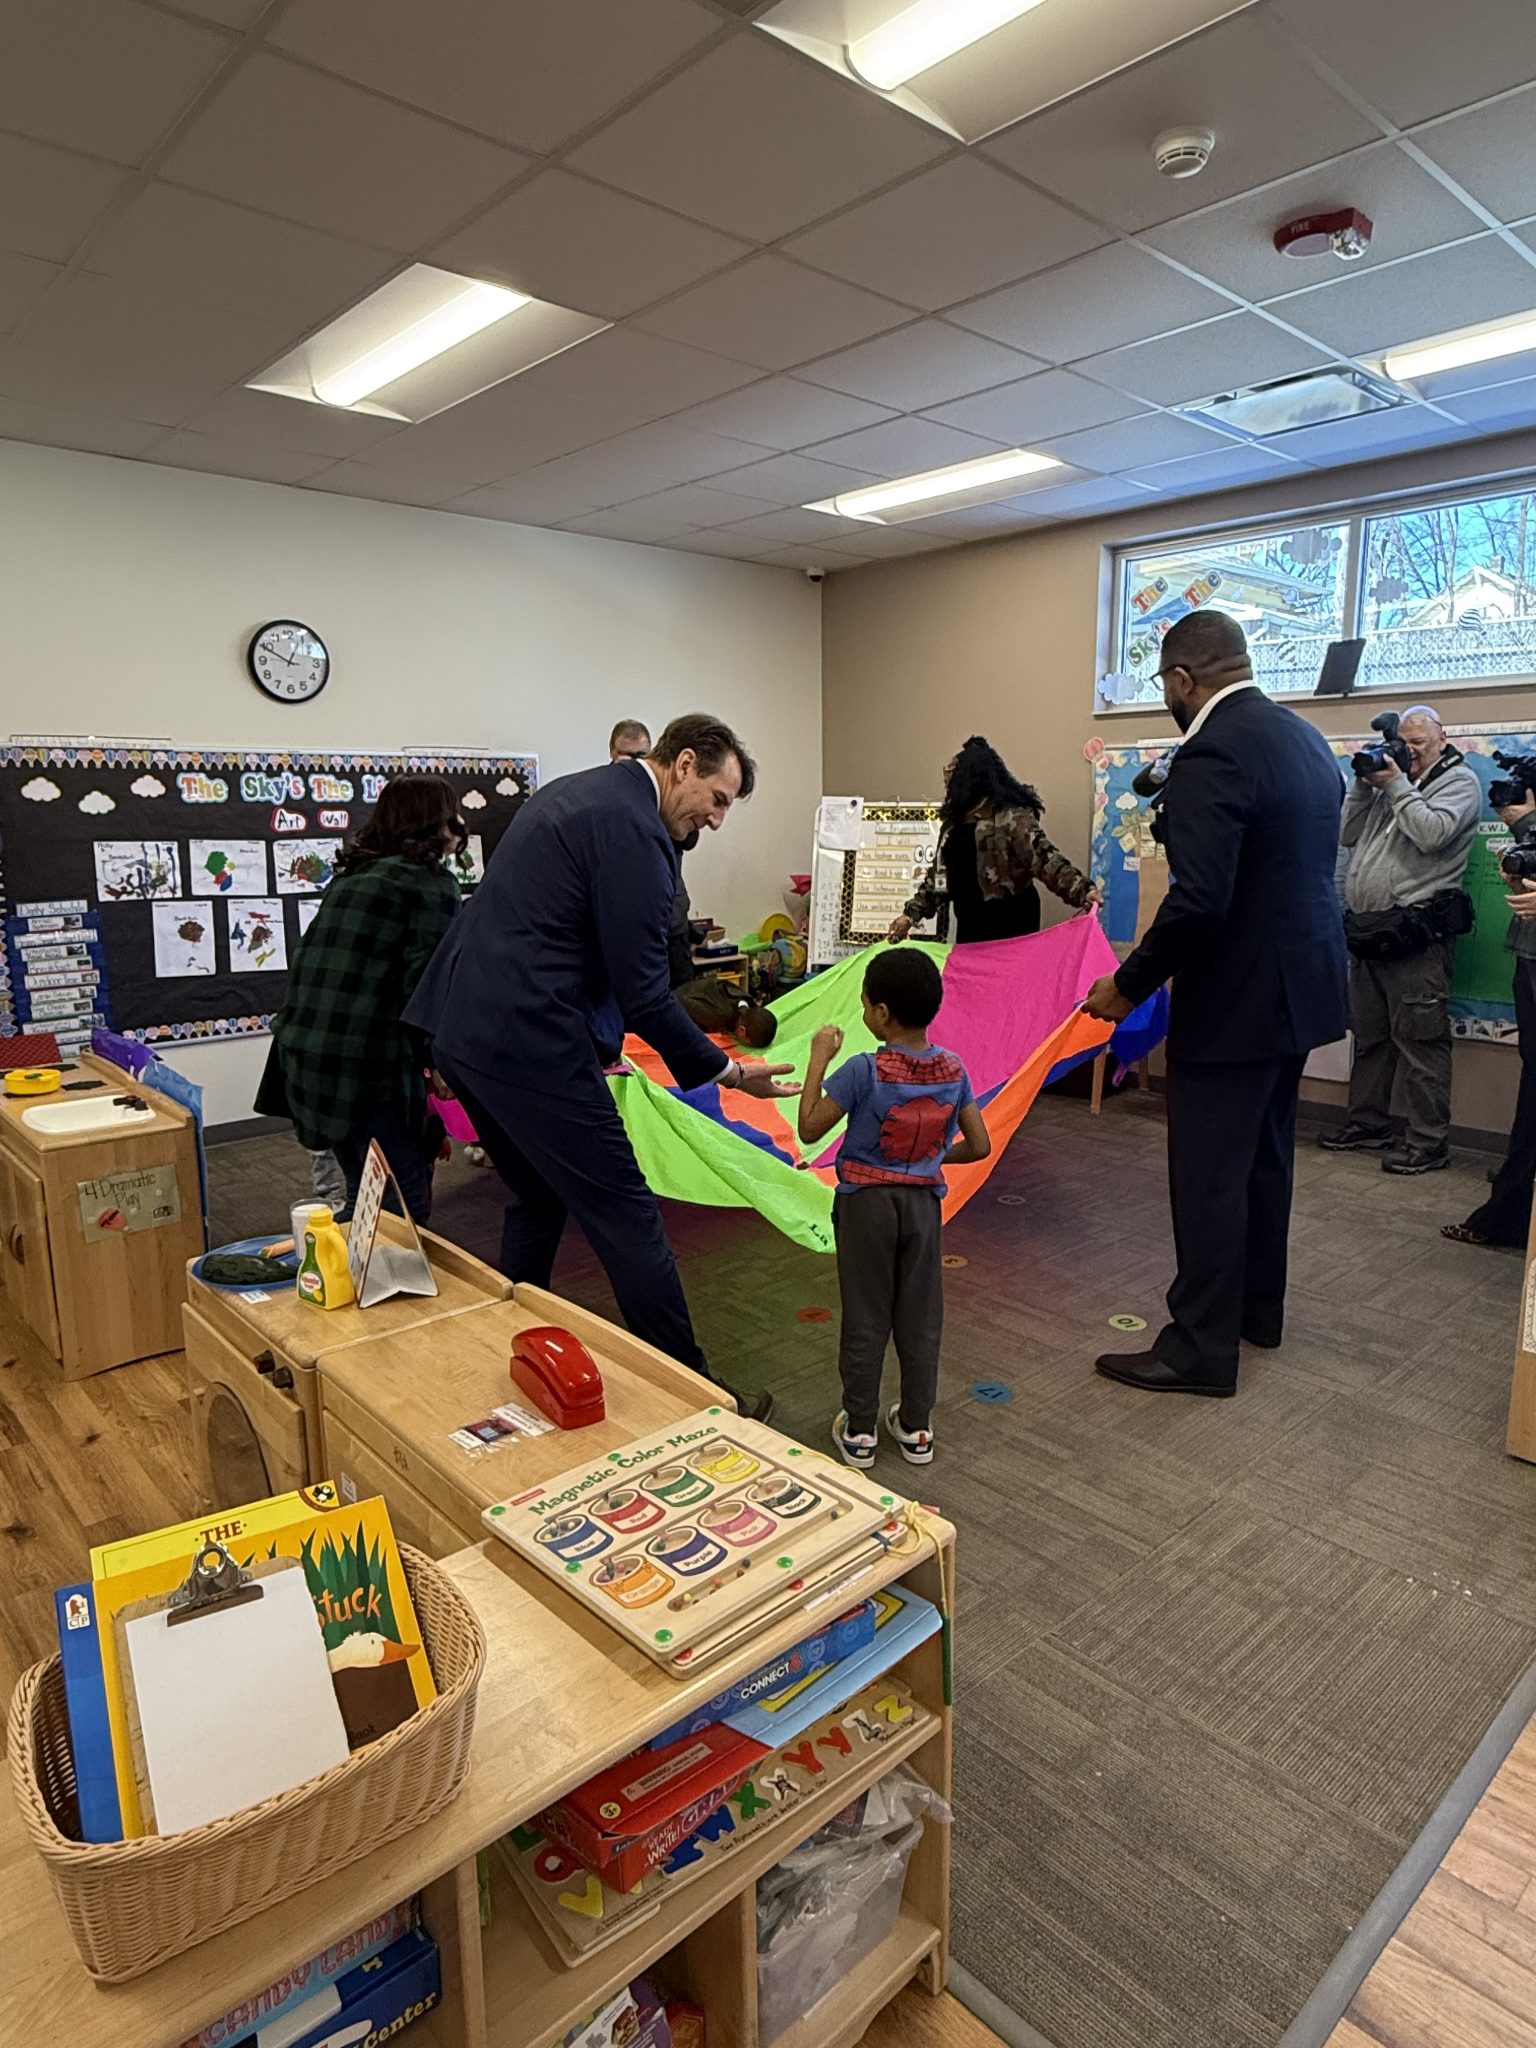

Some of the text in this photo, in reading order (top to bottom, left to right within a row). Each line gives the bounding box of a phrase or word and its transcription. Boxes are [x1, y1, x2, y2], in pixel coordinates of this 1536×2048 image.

[1291, 221, 1310, 235] FIRE
[1134, 579, 1167, 612] The
[1184, 573, 1220, 608] The
[271, 633, 280, 643] 11
[283, 630, 294, 640] 12
[258, 655, 267, 665] 9
[312, 658, 320, 668] 3
[263, 670, 272, 679] 8
[309, 672, 316, 681] 4
[274, 680, 281, 689] 7
[287, 684, 296, 694] 6
[299, 681, 308, 691] 5
[181, 775, 226, 800] The
[244, 775, 301, 803] Sky's
[312, 777, 351, 800] The
[277, 810, 347, 829] Art Wall
[84, 1168, 158, 1200] 4 Dramatic
[114, 1191, 141, 1210] Play
[1117, 1317, 1139, 1329] 10
[976, 1387, 1004, 1399] 17
[528, 1467, 618, 1516] Magnetic
[617, 1444, 666, 1469] Color
[666, 1426, 718, 1448] Maze
[674, 1485, 701, 1500] Green
[784, 1498, 808, 1511] Black
[630, 1512, 648, 1525] Red
[200, 1520, 243, 1545] THE
[573, 1539, 596, 1552] Blue
[683, 1550, 713, 1568] Purple
[740, 1664, 790, 1700] CONNECT
[647, 1825, 681, 1865] WRITE!
[203, 1911, 393, 2046] CANDY LAND
[363, 1991, 437, 2048] Center
